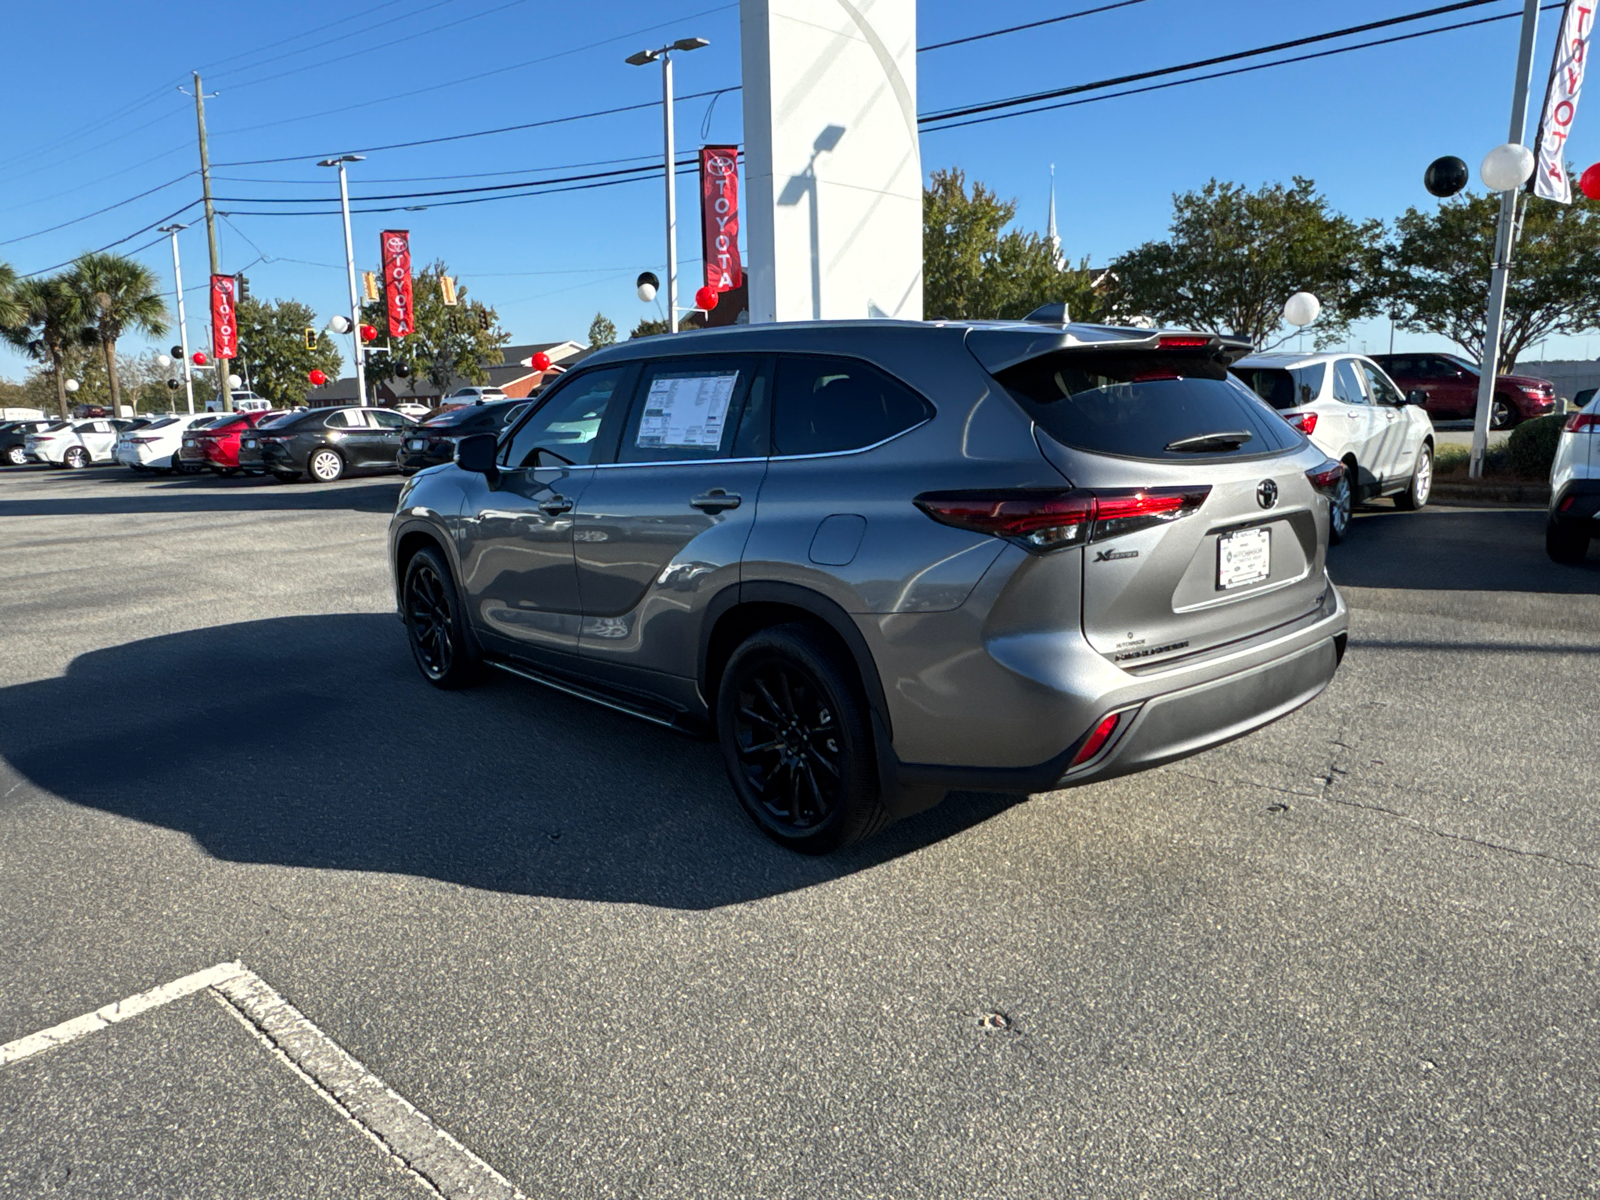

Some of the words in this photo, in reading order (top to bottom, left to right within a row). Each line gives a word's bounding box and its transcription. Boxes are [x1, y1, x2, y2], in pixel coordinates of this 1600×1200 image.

[1548, 5, 1592, 183] TOYOTA
[714, 179, 734, 288] TOYOTA
[219, 293, 233, 356] TOYOTA
[393, 254, 409, 333] TOYOTA
